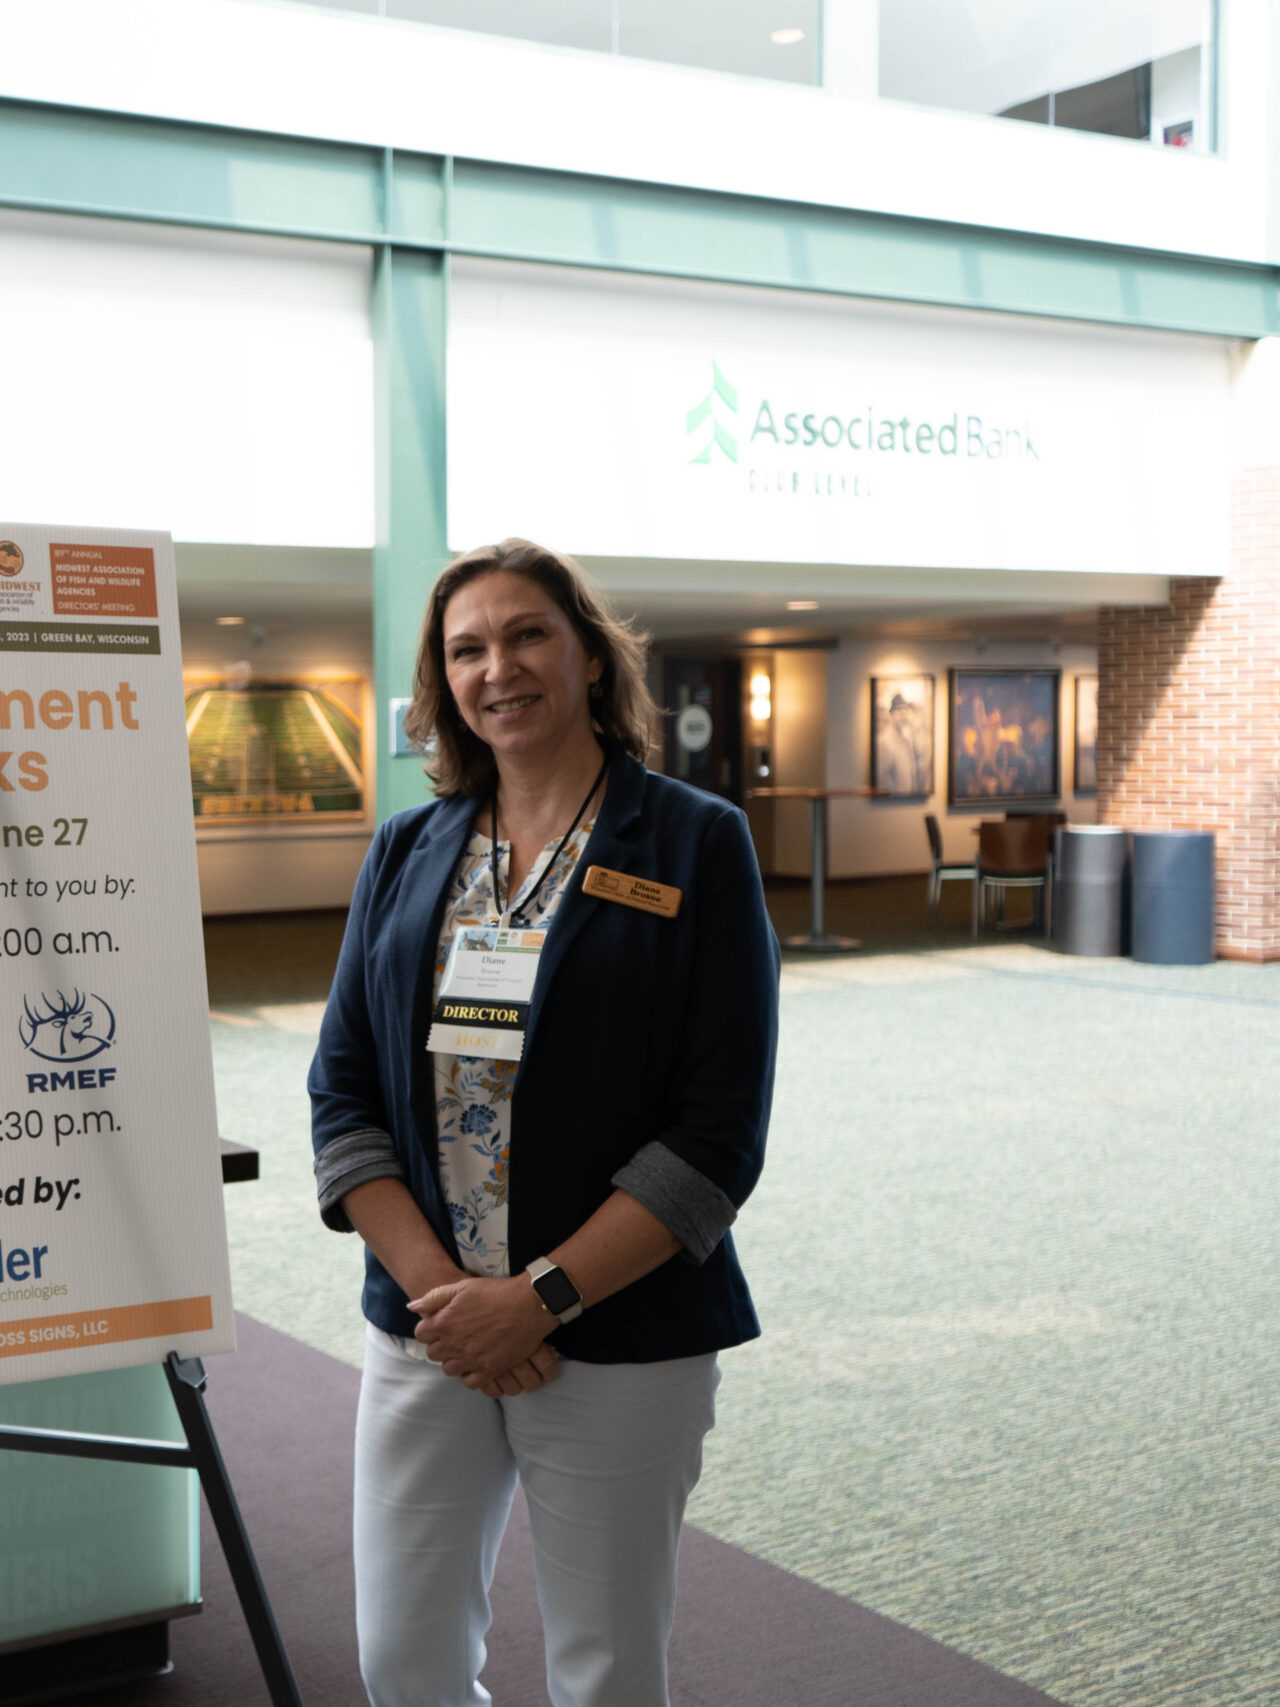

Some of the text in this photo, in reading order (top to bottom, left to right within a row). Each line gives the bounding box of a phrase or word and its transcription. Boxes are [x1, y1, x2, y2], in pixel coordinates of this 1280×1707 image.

[750, 397, 959, 455] Associated
[72, 550, 103, 560] ANNUAL
[55, 563, 145, 575] MIDWEST ASSOCIATION
[56, 575, 141, 587] OF FISH AND WILDLIFE
[57, 587, 96, 597] AGENCIES
[102, 602, 135, 612] MEETING
[6, 633, 30, 642] 2023
[41, 633, 73, 643] GREEN
[75, 634, 95, 645] BAY,
[98, 634, 150, 645] WISCONSIN
[53, 818, 89, 846] 27
[25, 877, 48, 898] to
[55, 879, 97, 902] you
[104, 874, 136, 900] by:
[634, 880, 661, 895] Diane
[52, 928, 120, 955] a.m.
[482, 955, 506, 966] Diane
[442, 1004, 519, 1023] DIRECTOR
[456, 1032, 503, 1049] HOST
[25, 1067, 117, 1093] RMEF
[53, 1108, 122, 1146] p.m.
[33, 1176, 82, 1213] by:
[29, 1323, 81, 1344] SIGNS,
[83, 1319, 109, 1336] LLC
